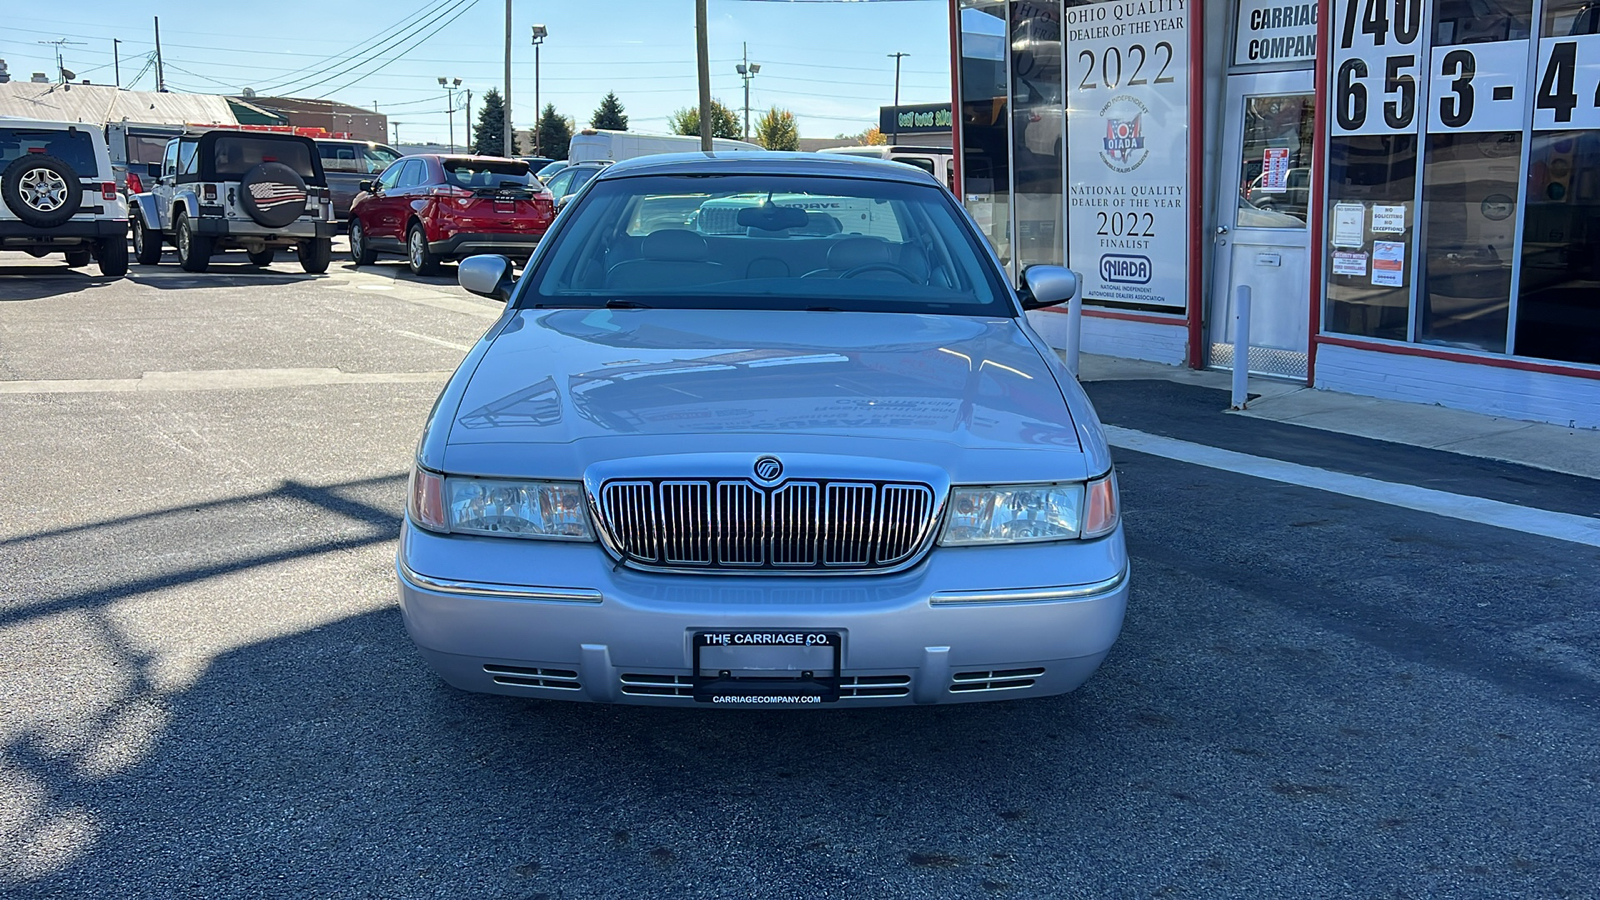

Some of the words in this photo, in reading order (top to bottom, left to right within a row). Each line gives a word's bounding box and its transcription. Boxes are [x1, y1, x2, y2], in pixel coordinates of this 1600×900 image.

[1068, 7, 1106, 24] OHIO
[1114, 0, 1185, 20] QUALITY
[1070, 26, 1109, 41] DEALER
[1112, 24, 1126, 36] OF
[1129, 21, 1150, 34] THE
[1154, 17, 1184, 31] YEAR
[1078, 41, 1174, 90] 2022
[1100, 101, 1111, 117] OHIO
[1112, 95, 1149, 114] INDEPENDENT
[1108, 138, 1137, 149] OIADA
[1071, 186, 1126, 195] NATIONAL
[1132, 186, 1183, 196] QUALITY
[1072, 199, 1109, 207] DEALER
[1113, 199, 1125, 207] OF
[1130, 199, 1149, 207] THE
[1154, 199, 1181, 208] YEAR
[1096, 212, 1154, 237] 2022
[1100, 239, 1149, 249] FINALIST
[1104, 260, 1146, 278] NIADA
[1135, 293, 1165, 301] ASSOCIATION
[704, 634, 731, 644] THE
[734, 634, 803, 644] CARRIAGE
[808, 634, 830, 644] CO.
